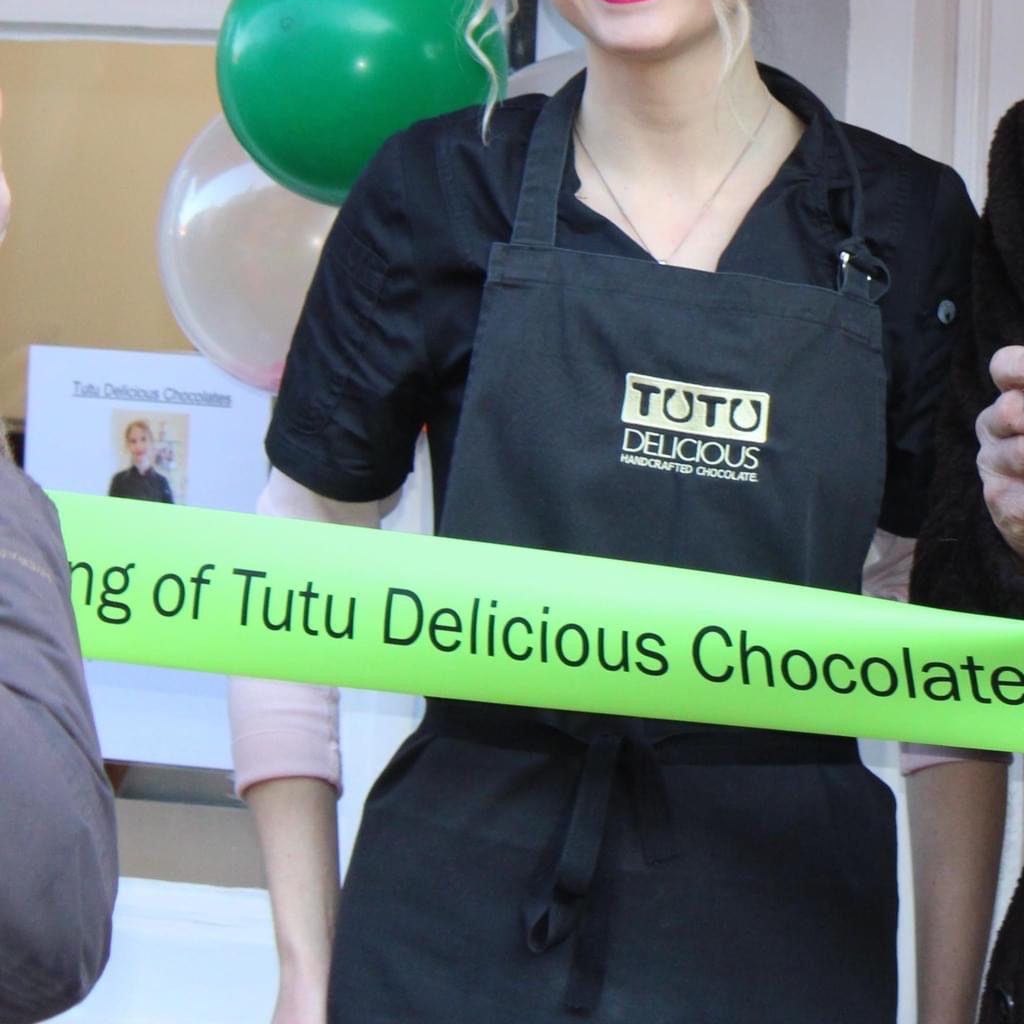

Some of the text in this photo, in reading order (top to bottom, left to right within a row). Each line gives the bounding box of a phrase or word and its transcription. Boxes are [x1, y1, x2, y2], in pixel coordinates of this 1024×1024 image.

[72, 380, 232, 407] Tutu Delicious Chocolates
[631, 382, 763, 433] TUTU
[620, 453, 759, 482] HANDCRAFTED CHOCOLATE
[622, 428, 761, 470] DELICIOUS
[153, 564, 215, 620] of
[233, 568, 356, 640] Tutu
[383, 587, 669, 677] Delicious
